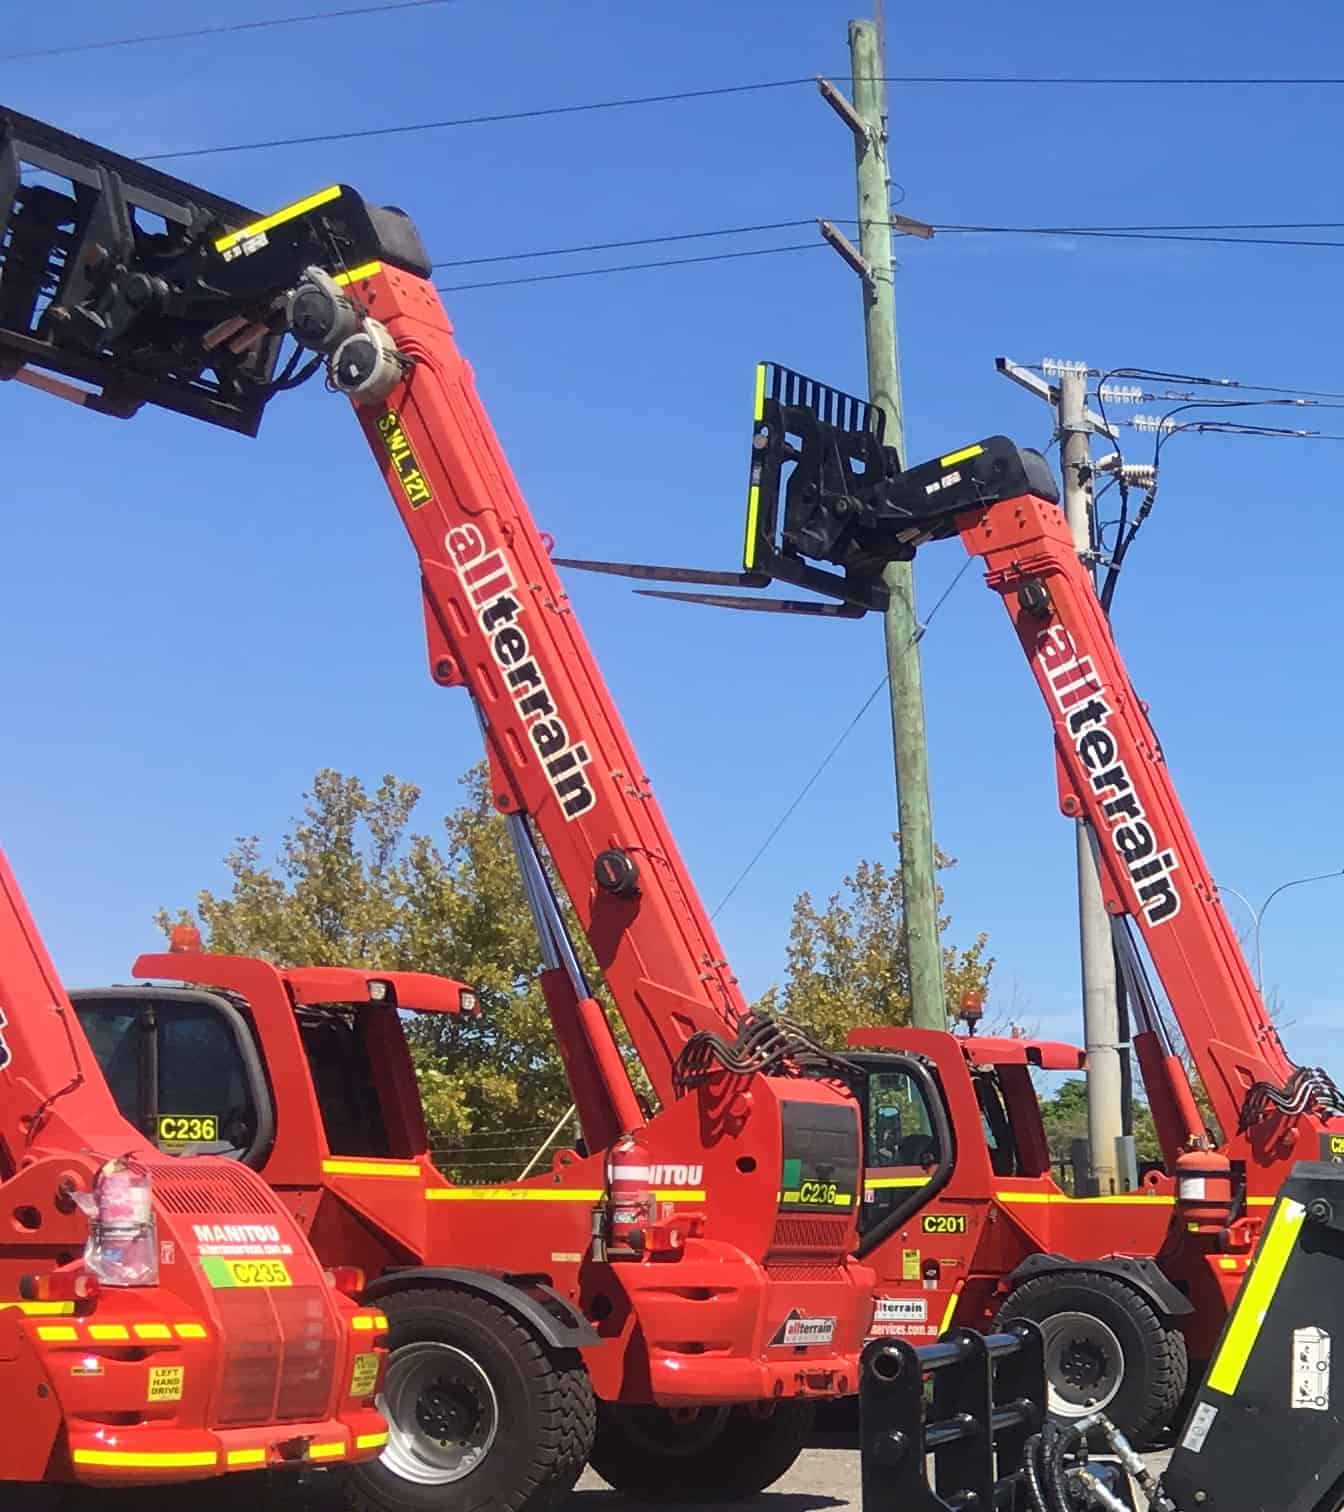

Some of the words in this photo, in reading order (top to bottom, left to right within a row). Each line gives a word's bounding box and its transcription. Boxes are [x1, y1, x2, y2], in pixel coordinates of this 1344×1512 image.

[402, 469, 431, 502] 12T
[445, 522, 597, 823] allterrain
[1035, 623, 1180, 928] allterrain
[160, 1118, 215, 1140] C236
[800, 1182, 838, 1204] C236
[192, 1224, 281, 1243] MANITOU
[924, 1216, 965, 1233] C201
[232, 1263, 288, 1284] C235
[152, 1378, 181, 1387] HAND
[155, 1368, 180, 1378] LEFT
[150, 1386, 181, 1396] DRIVE
